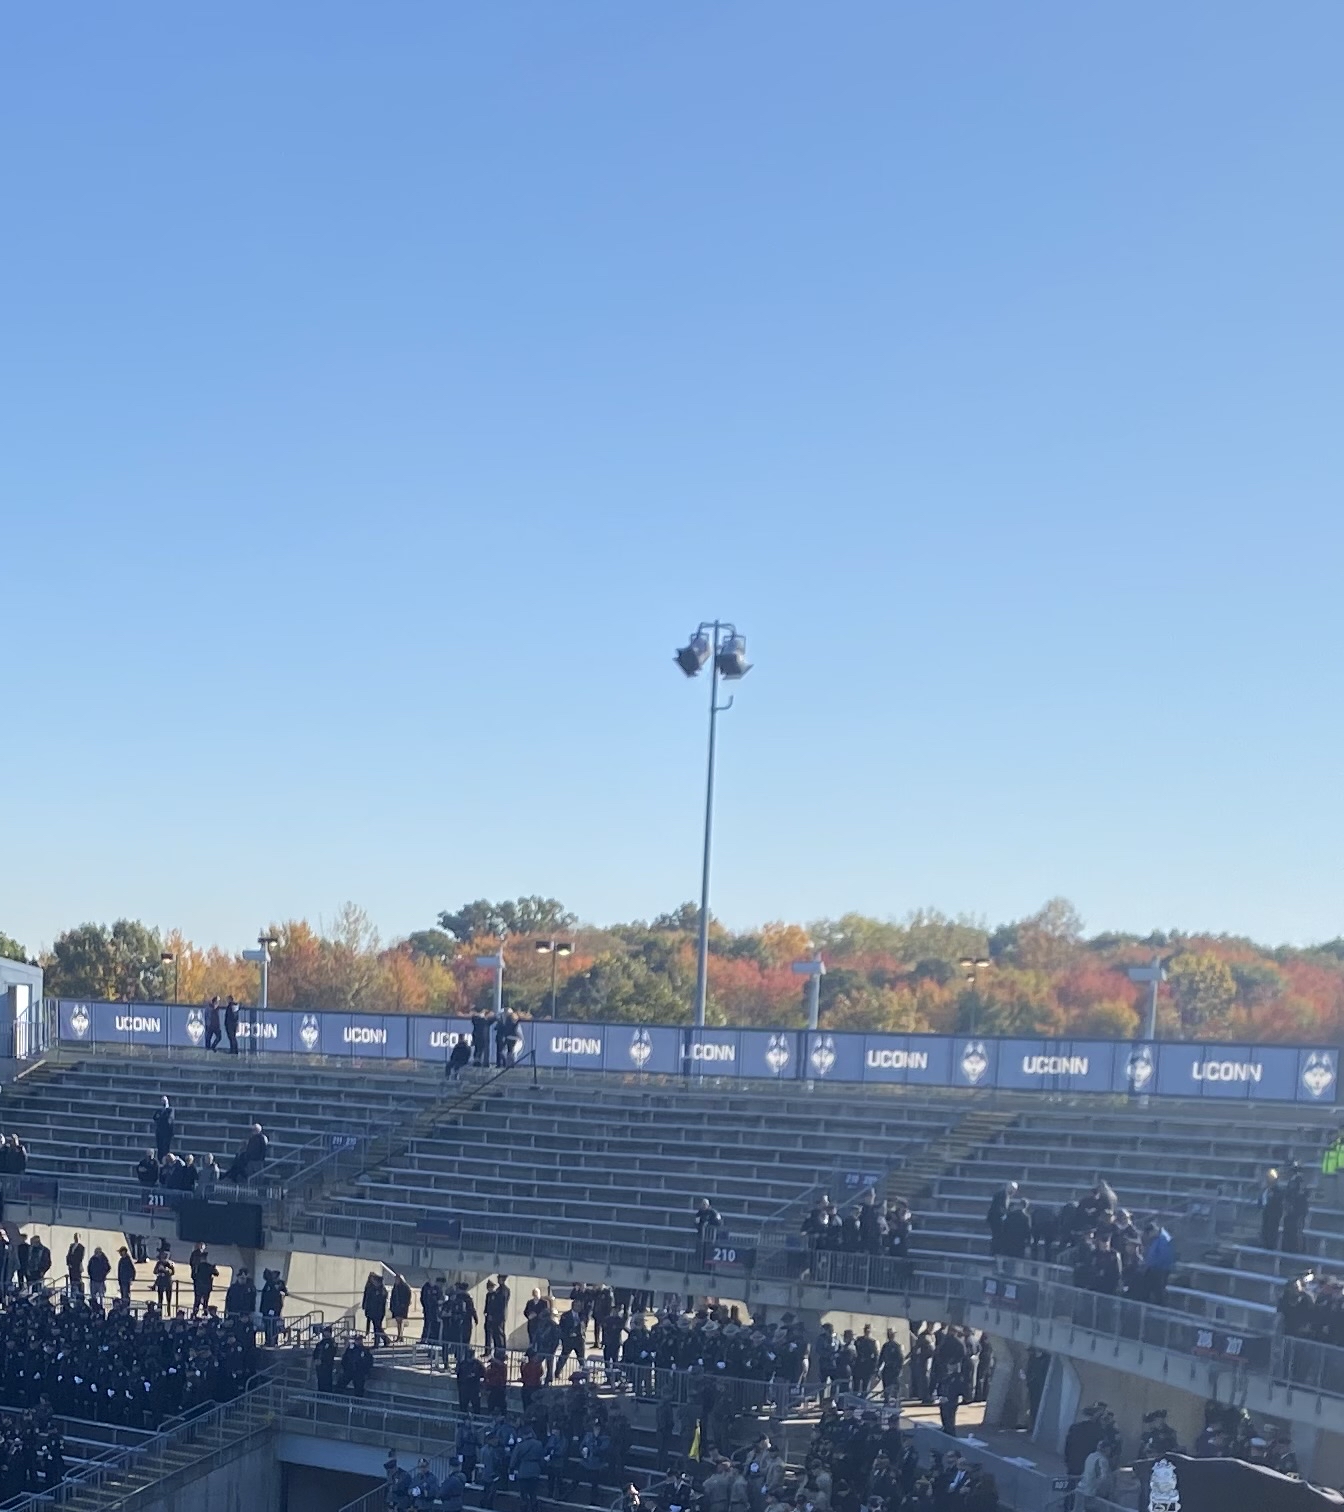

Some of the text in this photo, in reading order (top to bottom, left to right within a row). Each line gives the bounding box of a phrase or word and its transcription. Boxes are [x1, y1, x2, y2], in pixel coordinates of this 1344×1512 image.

[115, 1016, 161, 1032] UCONN
[344, 1027, 387, 1044] UCONN
[552, 1037, 601, 1055] UCONN
[867, 1050, 928, 1069] UCONN
[1023, 1056, 1088, 1075] UCONN
[1192, 1061, 1263, 1081] UCONN
[148, 1194, 164, 1206] 211
[713, 1248, 736, 1262] 210
